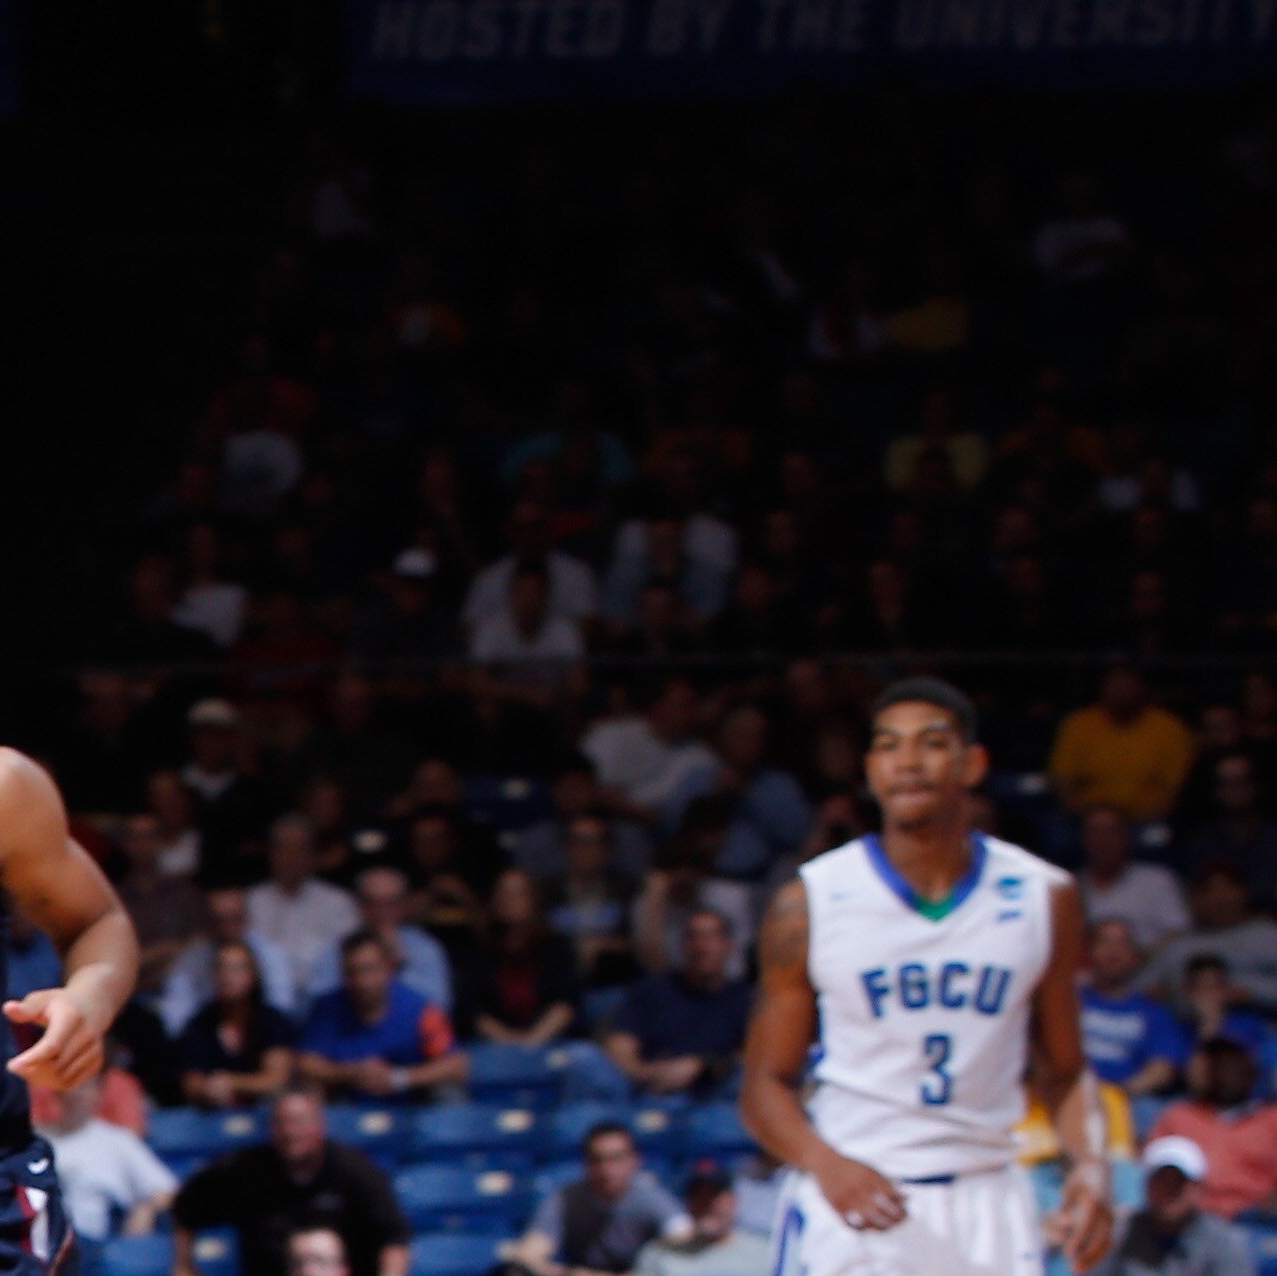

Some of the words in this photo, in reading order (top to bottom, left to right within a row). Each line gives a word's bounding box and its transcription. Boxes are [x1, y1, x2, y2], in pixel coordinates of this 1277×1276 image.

[369, 0, 627, 61] HOSTED
[647, 0, 731, 56] BY
[859, 960, 1015, 1019] FGCU
[920, 1032, 954, 1106] 3
